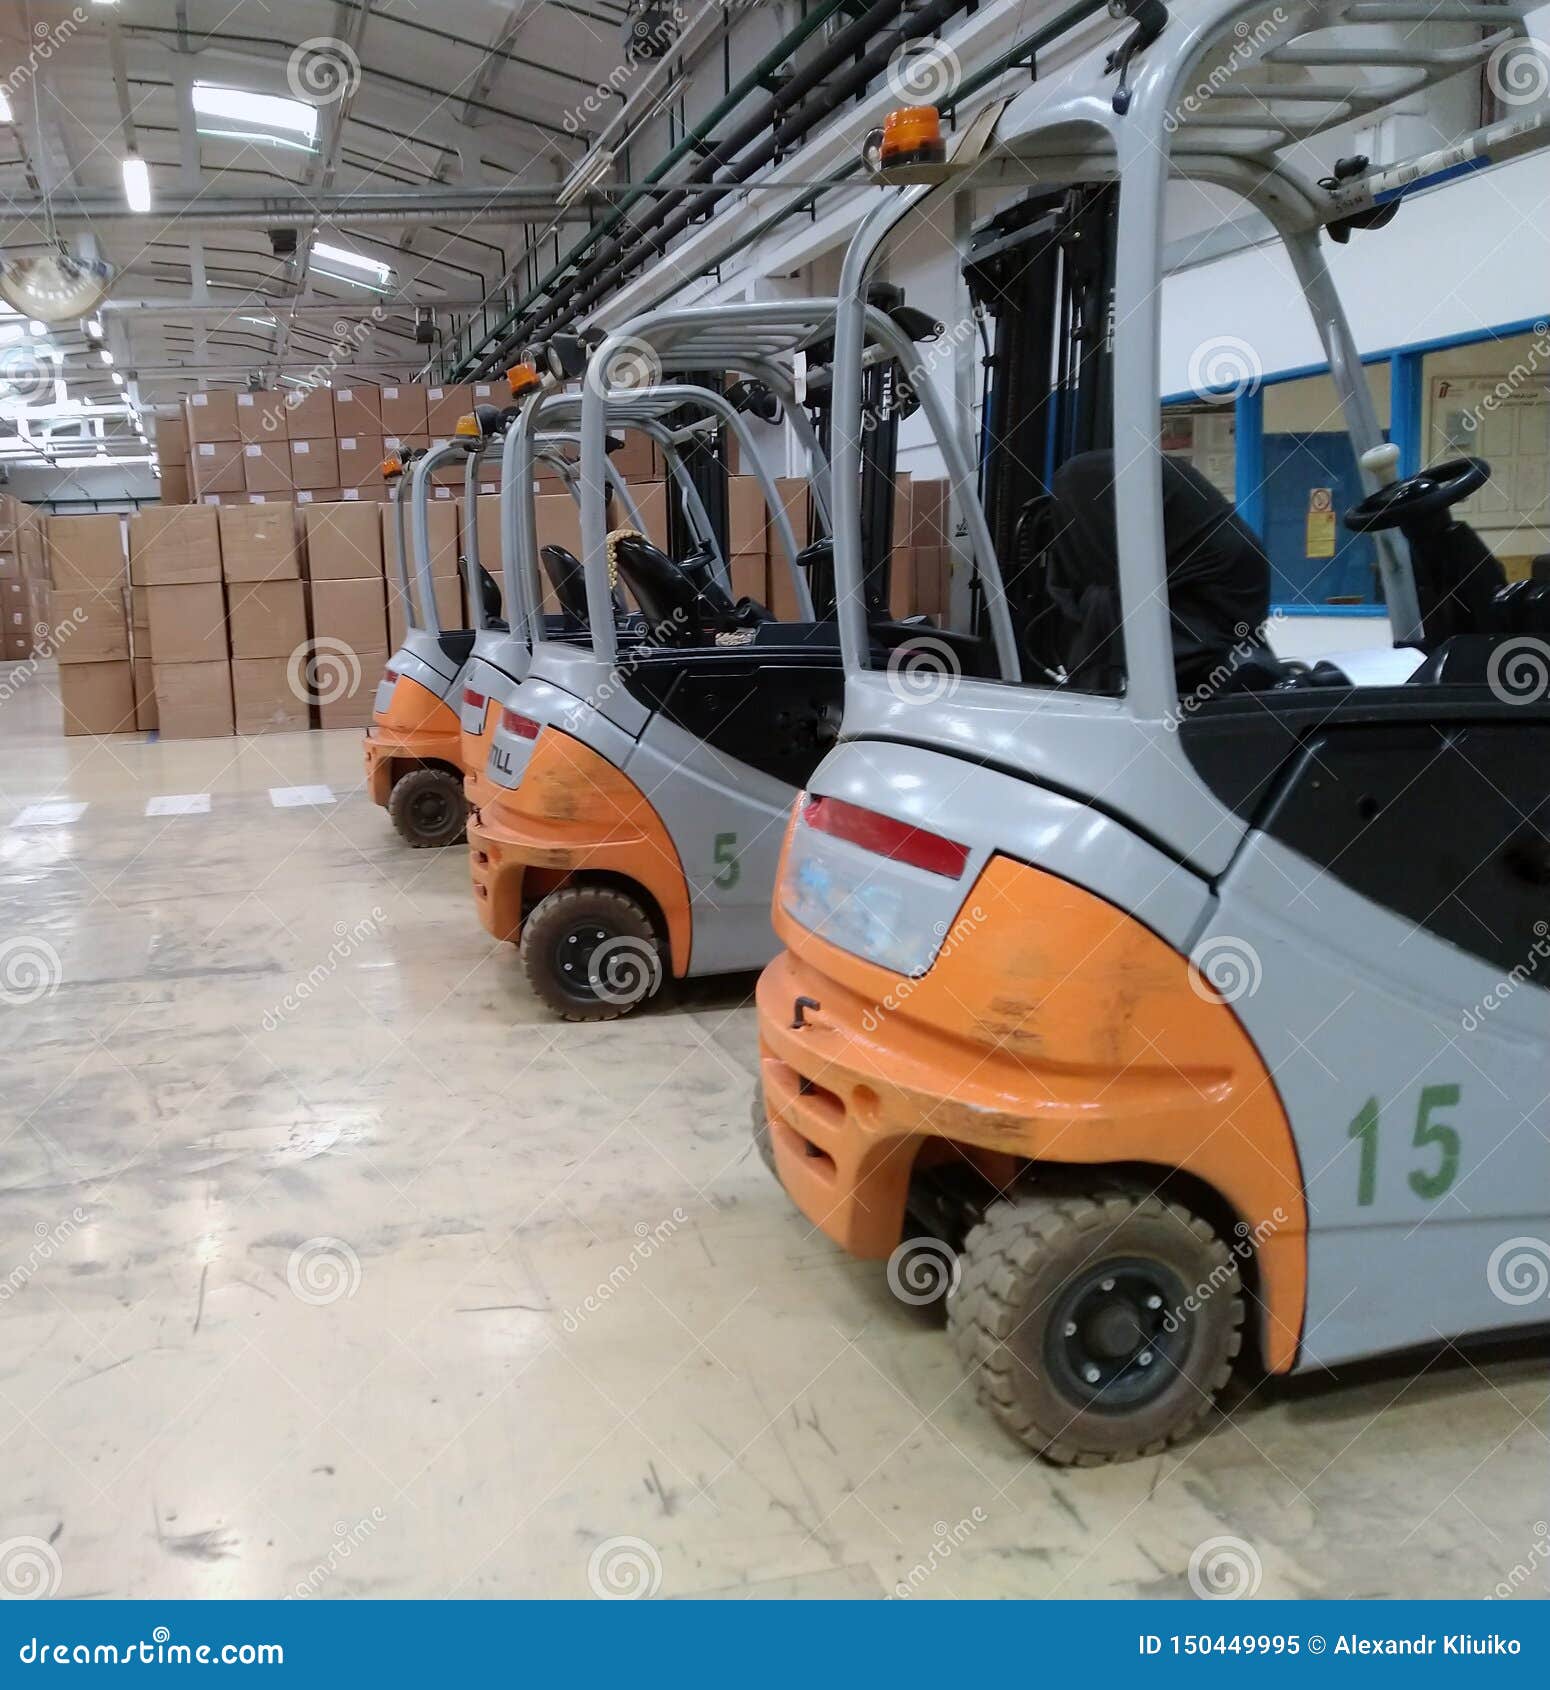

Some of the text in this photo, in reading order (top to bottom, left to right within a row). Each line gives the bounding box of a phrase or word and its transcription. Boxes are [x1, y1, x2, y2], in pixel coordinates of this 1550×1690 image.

[881, 366, 893, 422] STILL
[713, 832, 741, 891] 5
[1347, 1083, 1461, 1207] 15
